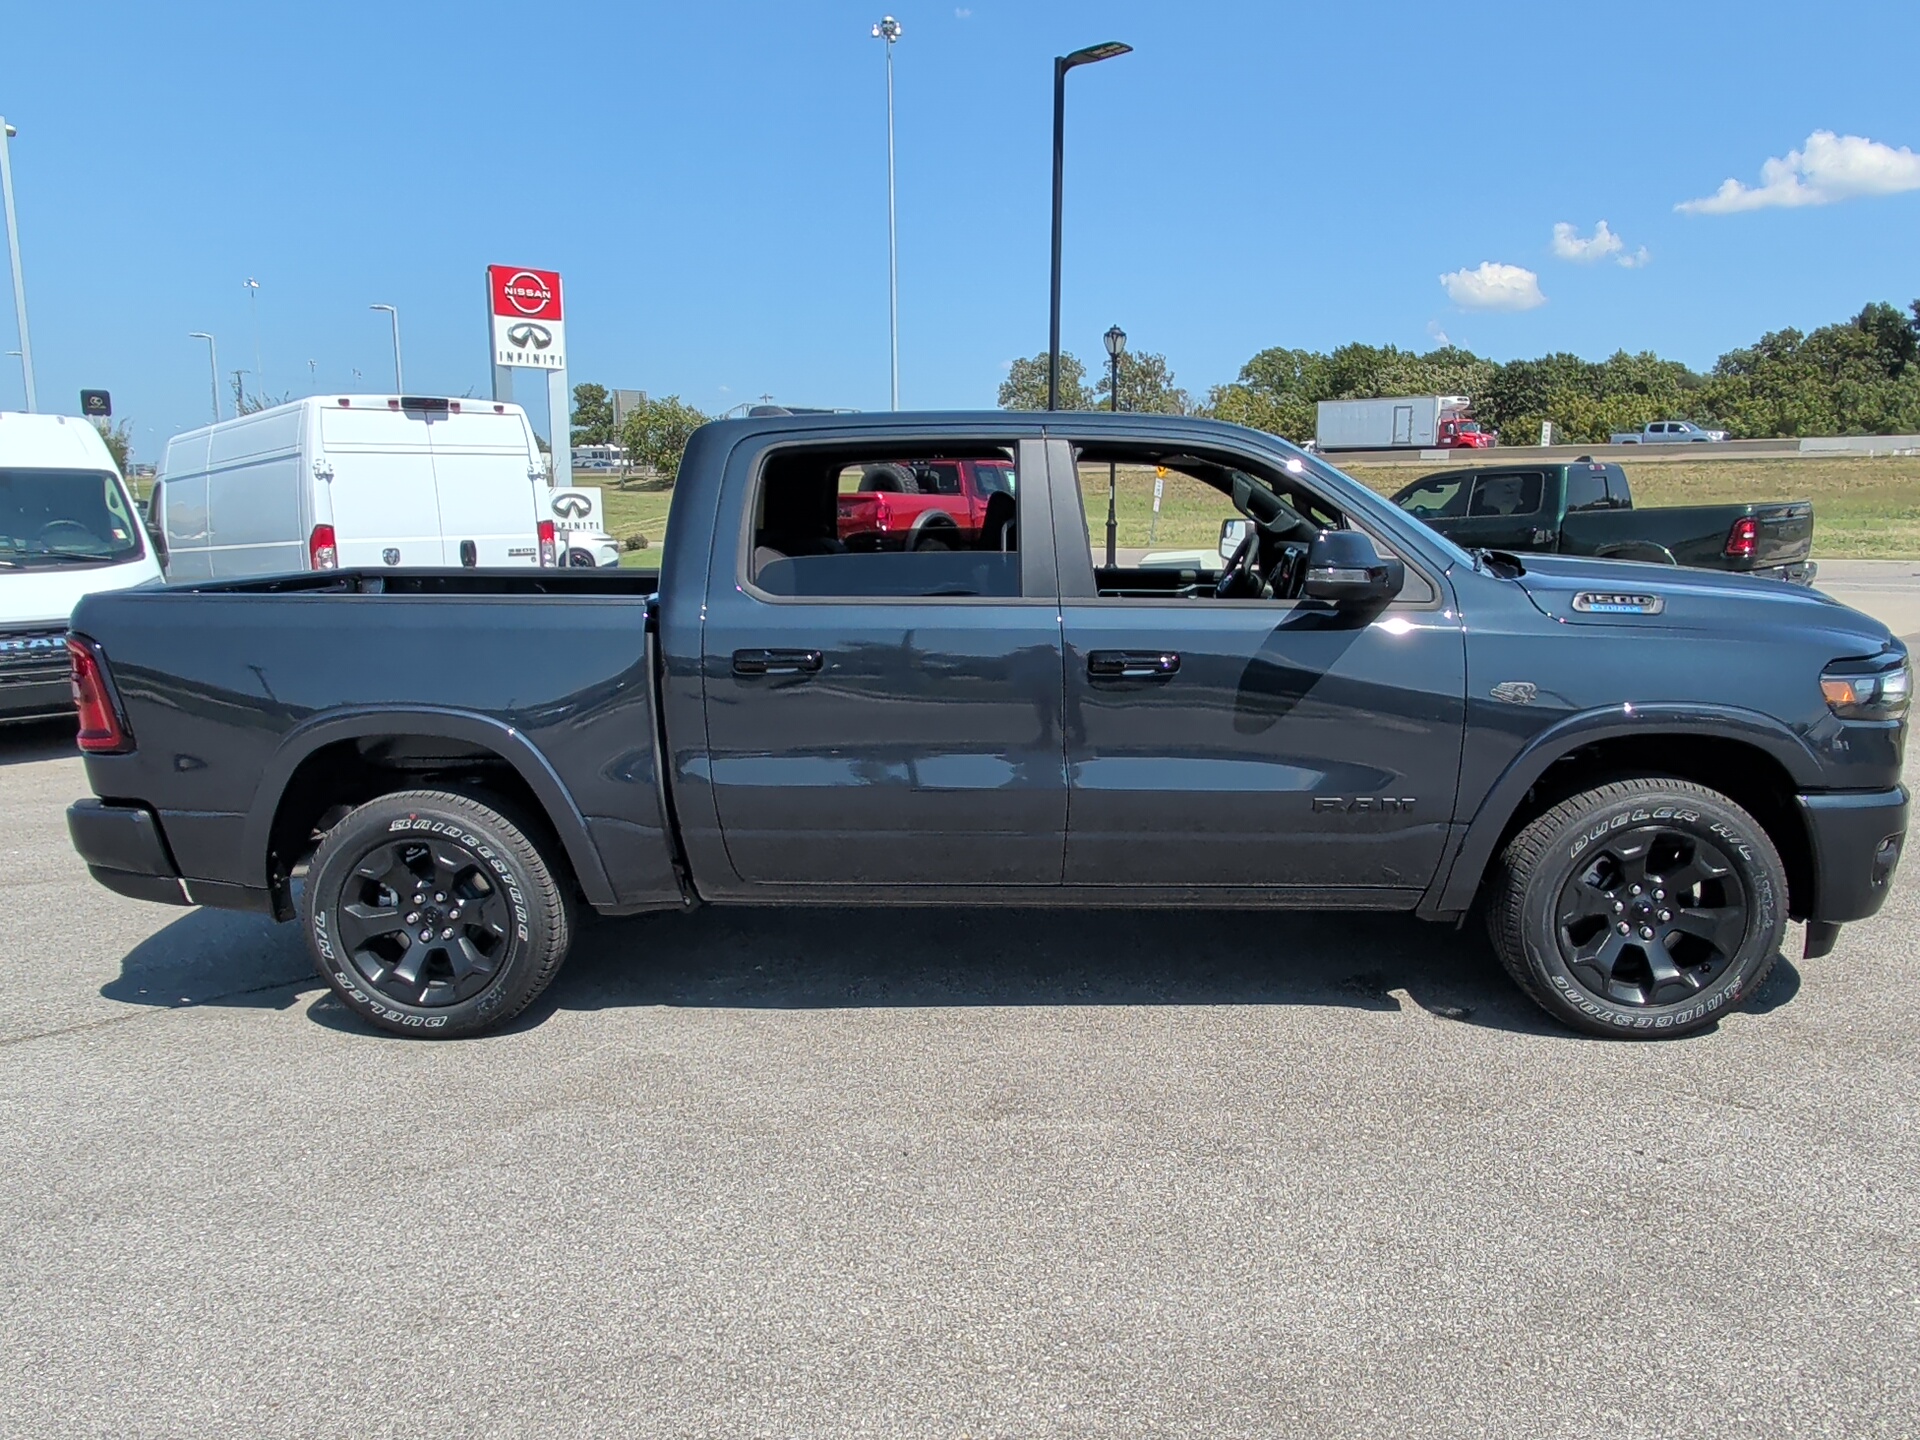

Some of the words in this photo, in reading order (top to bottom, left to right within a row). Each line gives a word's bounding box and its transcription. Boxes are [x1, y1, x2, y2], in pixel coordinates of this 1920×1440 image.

[504, 286, 551, 299] NISSAN
[499, 351, 562, 366] INFINITI
[554, 522, 600, 530] FINITI
[1585, 594, 1656, 606] 1500
[1312, 797, 1418, 814] RAM
[1570, 807, 1700, 859] DUELER
[1710, 822, 1752, 861] H/L
[389, 819, 529, 942] BRIDGESTONE
[334, 971, 448, 1027] DUELER
[1551, 975, 1744, 1029] BRIDGESTONE
